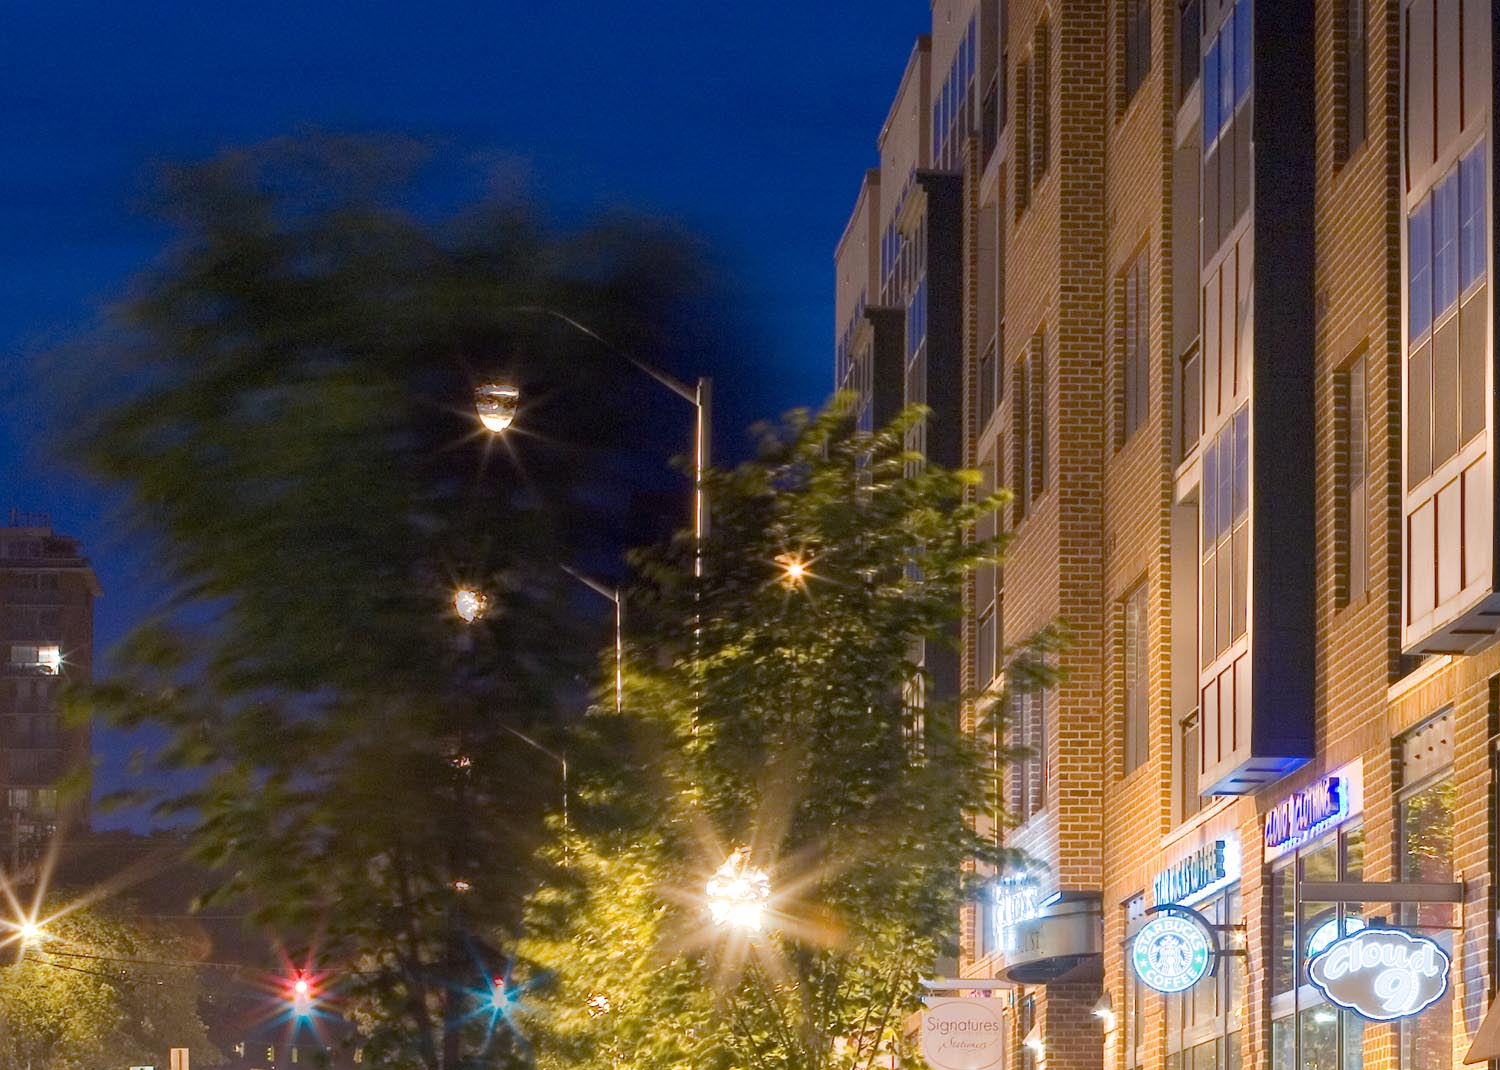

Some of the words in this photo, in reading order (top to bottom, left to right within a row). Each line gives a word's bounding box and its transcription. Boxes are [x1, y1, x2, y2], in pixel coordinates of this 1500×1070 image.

[1138, 921, 1203, 953] STARBUCKS
[1323, 939, 1439, 980] Cloud
[1146, 967, 1197, 987] COFFEE
[1374, 968, 1419, 1012] 9
[927, 1016, 999, 1035] Signatures
